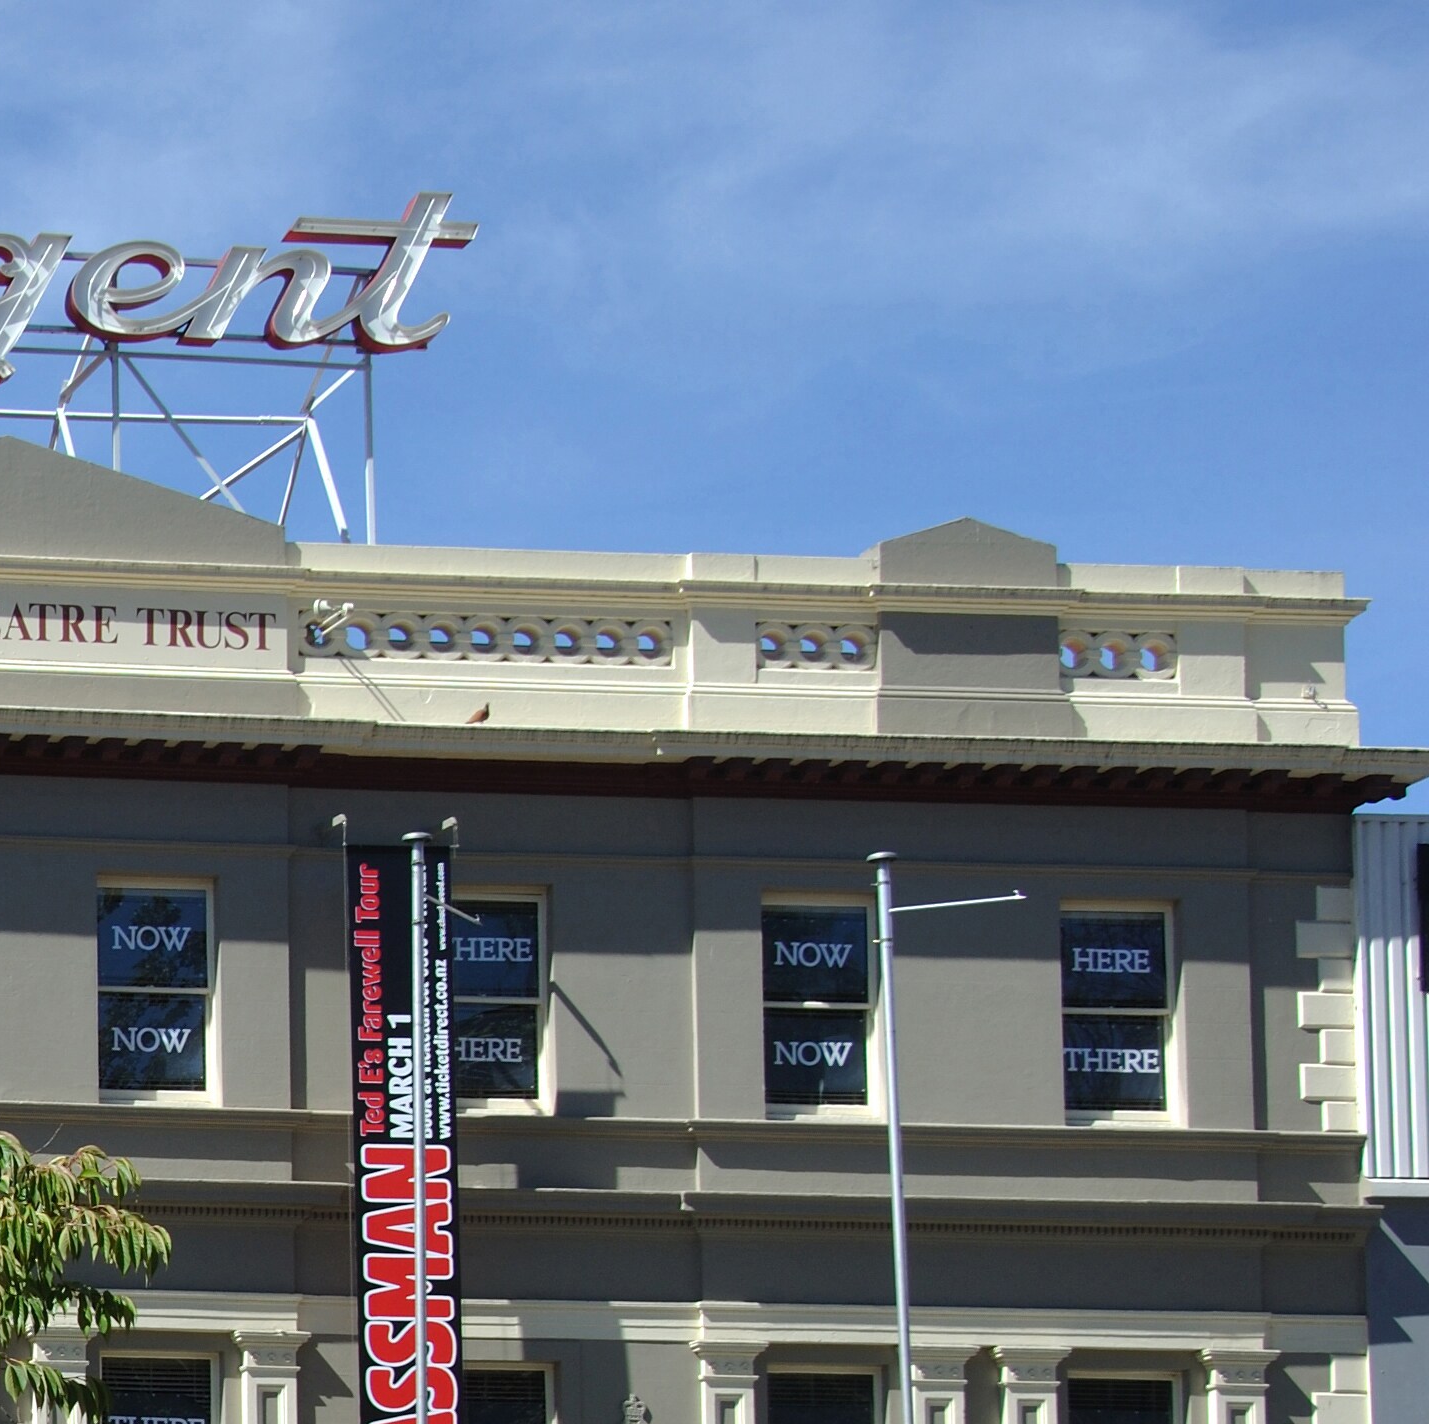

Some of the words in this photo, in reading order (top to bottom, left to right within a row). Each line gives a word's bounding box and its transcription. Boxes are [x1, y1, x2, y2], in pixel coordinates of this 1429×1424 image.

[137, 607, 277, 652] TRUST
[354, 862, 381, 923] Tour
[111, 924, 192, 952] NOW
[452, 936, 533, 963] HERE
[773, 940, 853, 968] NOW
[1071, 947, 1151, 975] HERE
[354, 929, 384, 1042] Farewell
[386, 1013, 412, 1029] 1
[111, 1027, 192, 1054] NOW
[433, 959, 452, 1140] www.ticketdirect.co.nz
[773, 1041, 853, 1068] NOW
[357, 1048, 385, 1085] E's
[1063, 1047, 1160, 1074] THERE
[387, 1036, 414, 1139] MARCH
[357, 1091, 385, 1137] Ted
